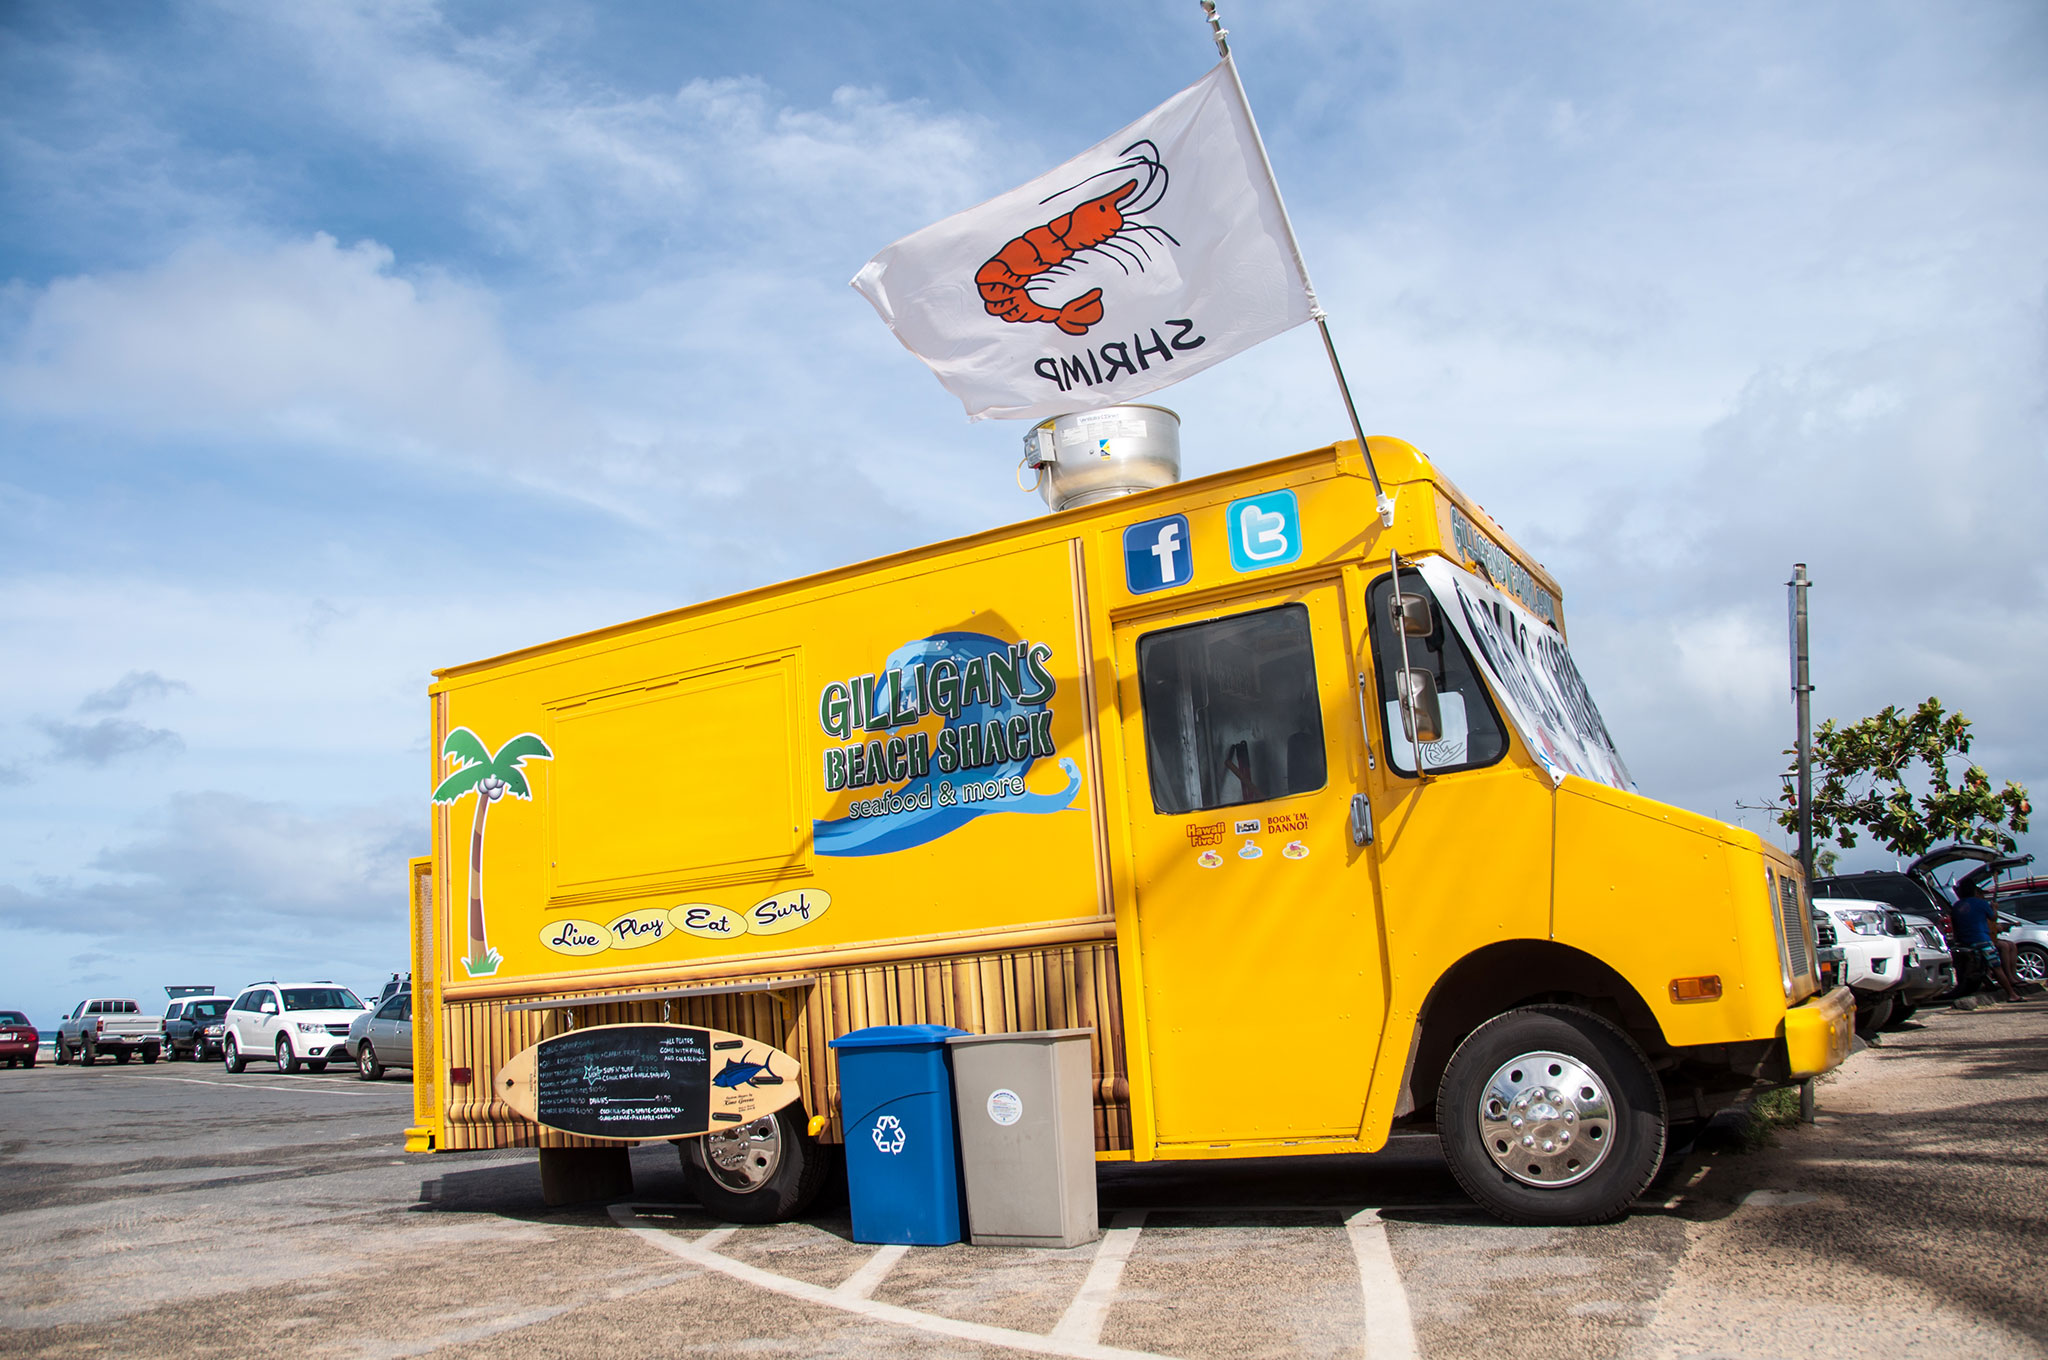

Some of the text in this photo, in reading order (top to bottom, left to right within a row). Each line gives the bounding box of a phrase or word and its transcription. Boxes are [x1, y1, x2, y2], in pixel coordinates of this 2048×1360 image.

[820, 640, 1057, 741] GILLIGAN'S
[823, 709, 1057, 793] BEACH SHACK
[849, 776, 1025, 820] seafood & more
[1186, 821, 1226, 838] Hawaii
[1267, 815, 1292, 825] BOOK
[1267, 820, 1309, 835] DANNO!
[685, 908, 731, 933] Eat
[754, 893, 811, 925] Surf
[552, 922, 600, 947] Live
[612, 917, 664, 941] Play
